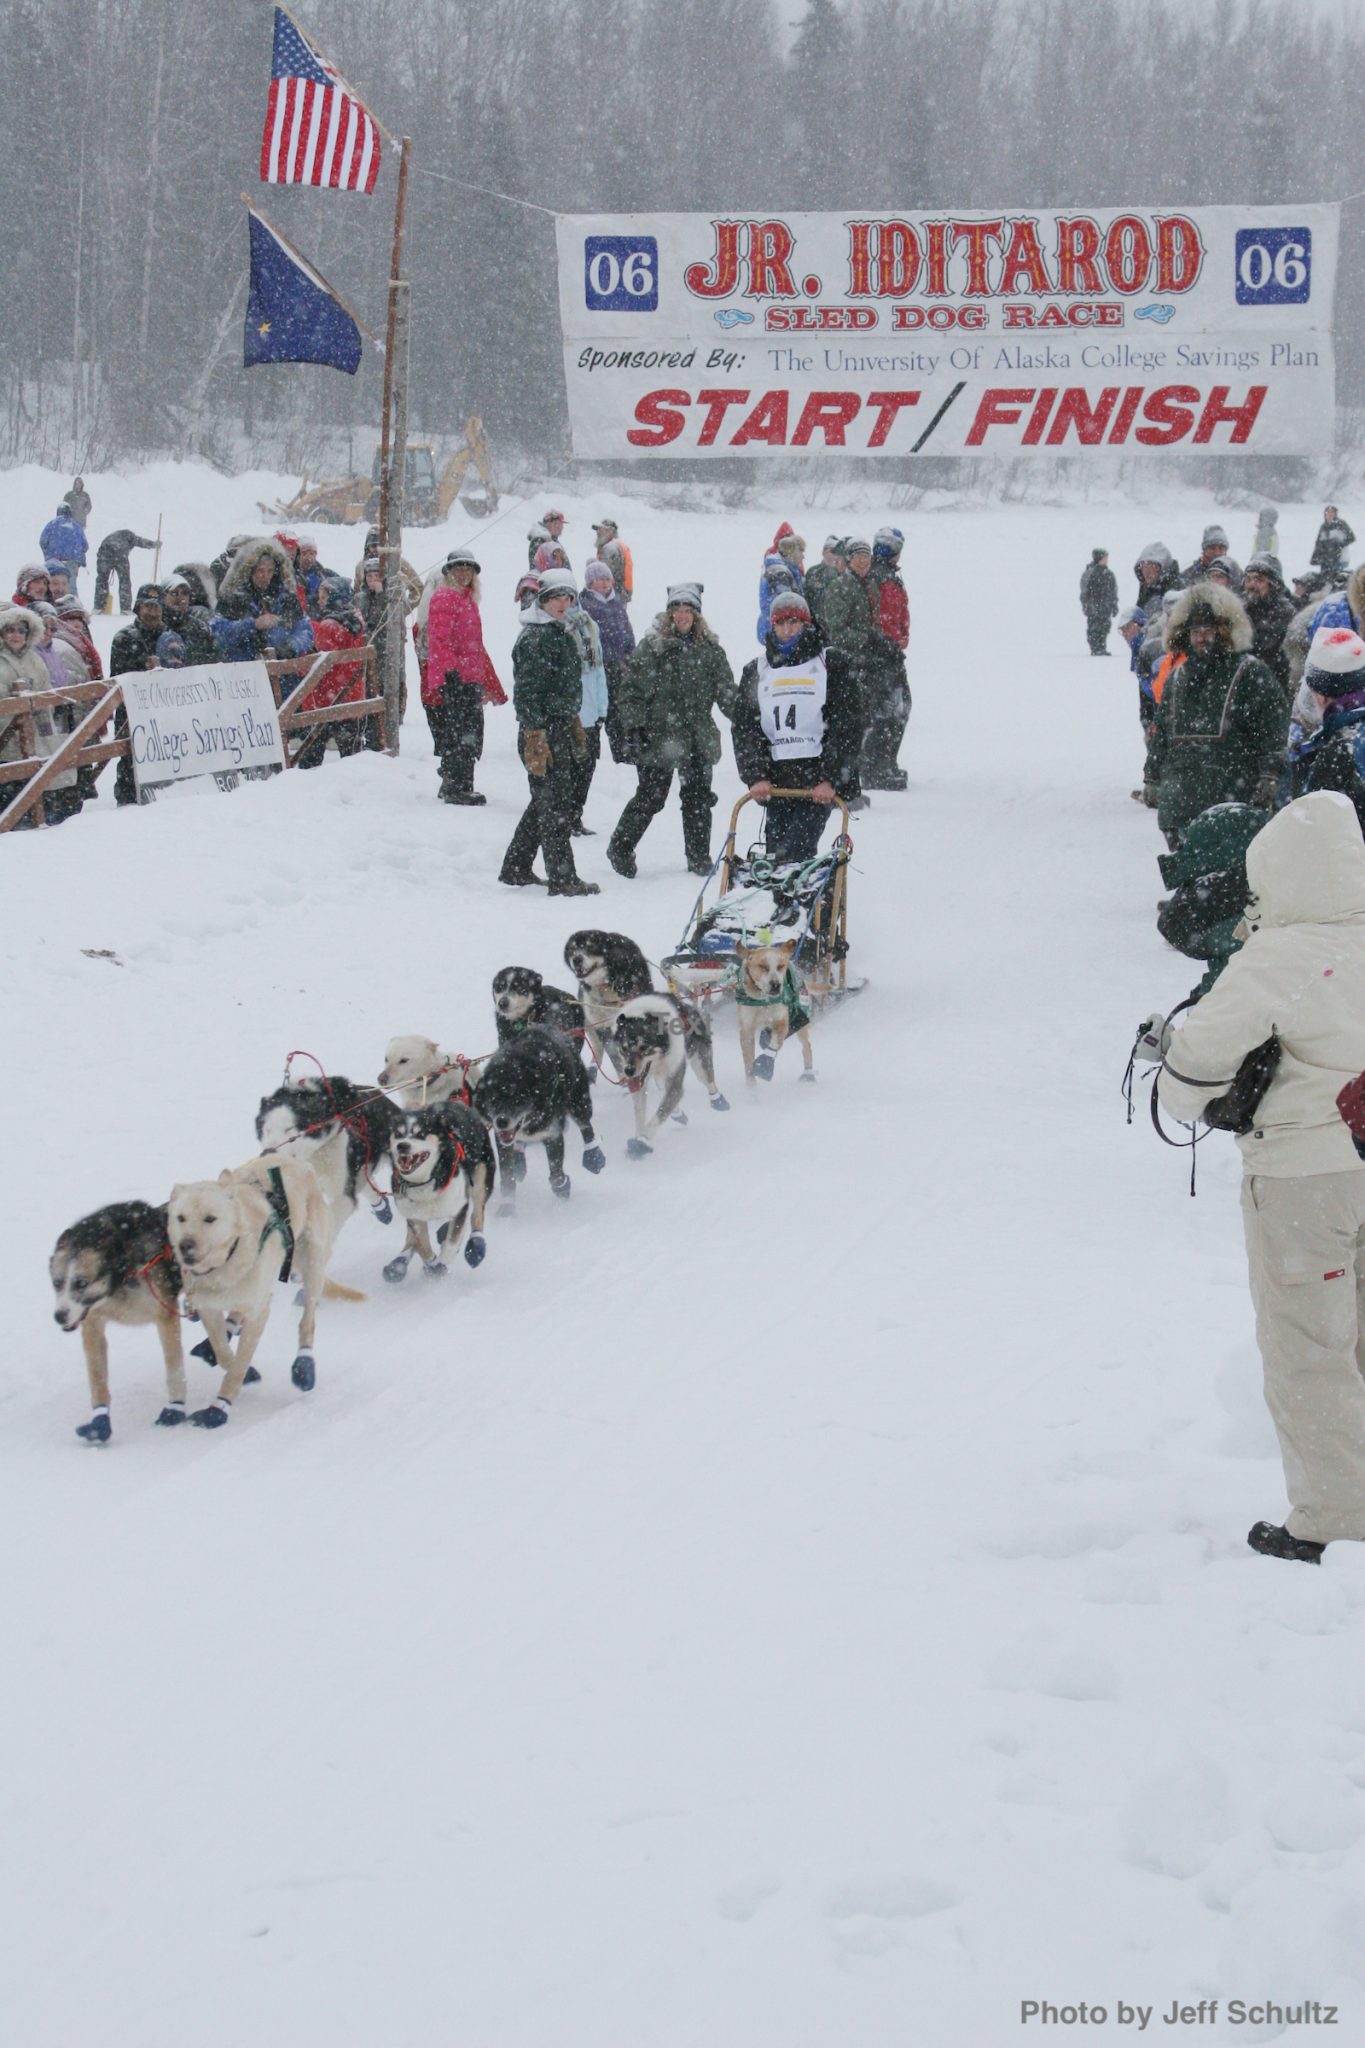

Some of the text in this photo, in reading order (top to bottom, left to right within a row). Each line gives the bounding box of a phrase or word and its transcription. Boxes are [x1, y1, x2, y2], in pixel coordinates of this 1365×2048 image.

[588, 252, 653, 296] 06
[684, 214, 1207, 302] JR. IDITAROD
[1240, 243, 1308, 289] 06
[765, 301, 1125, 331] SLED DOG RACE
[577, 343, 1320, 376] Sponsored By: The University Of Alaska College Savings Plan
[150, 681, 208, 709] UNIVERSITY
[223, 677, 260, 700] LASKA
[773, 704, 796, 732] 14
[132, 718, 189, 774] College
[242, 708, 275, 748] Plan
